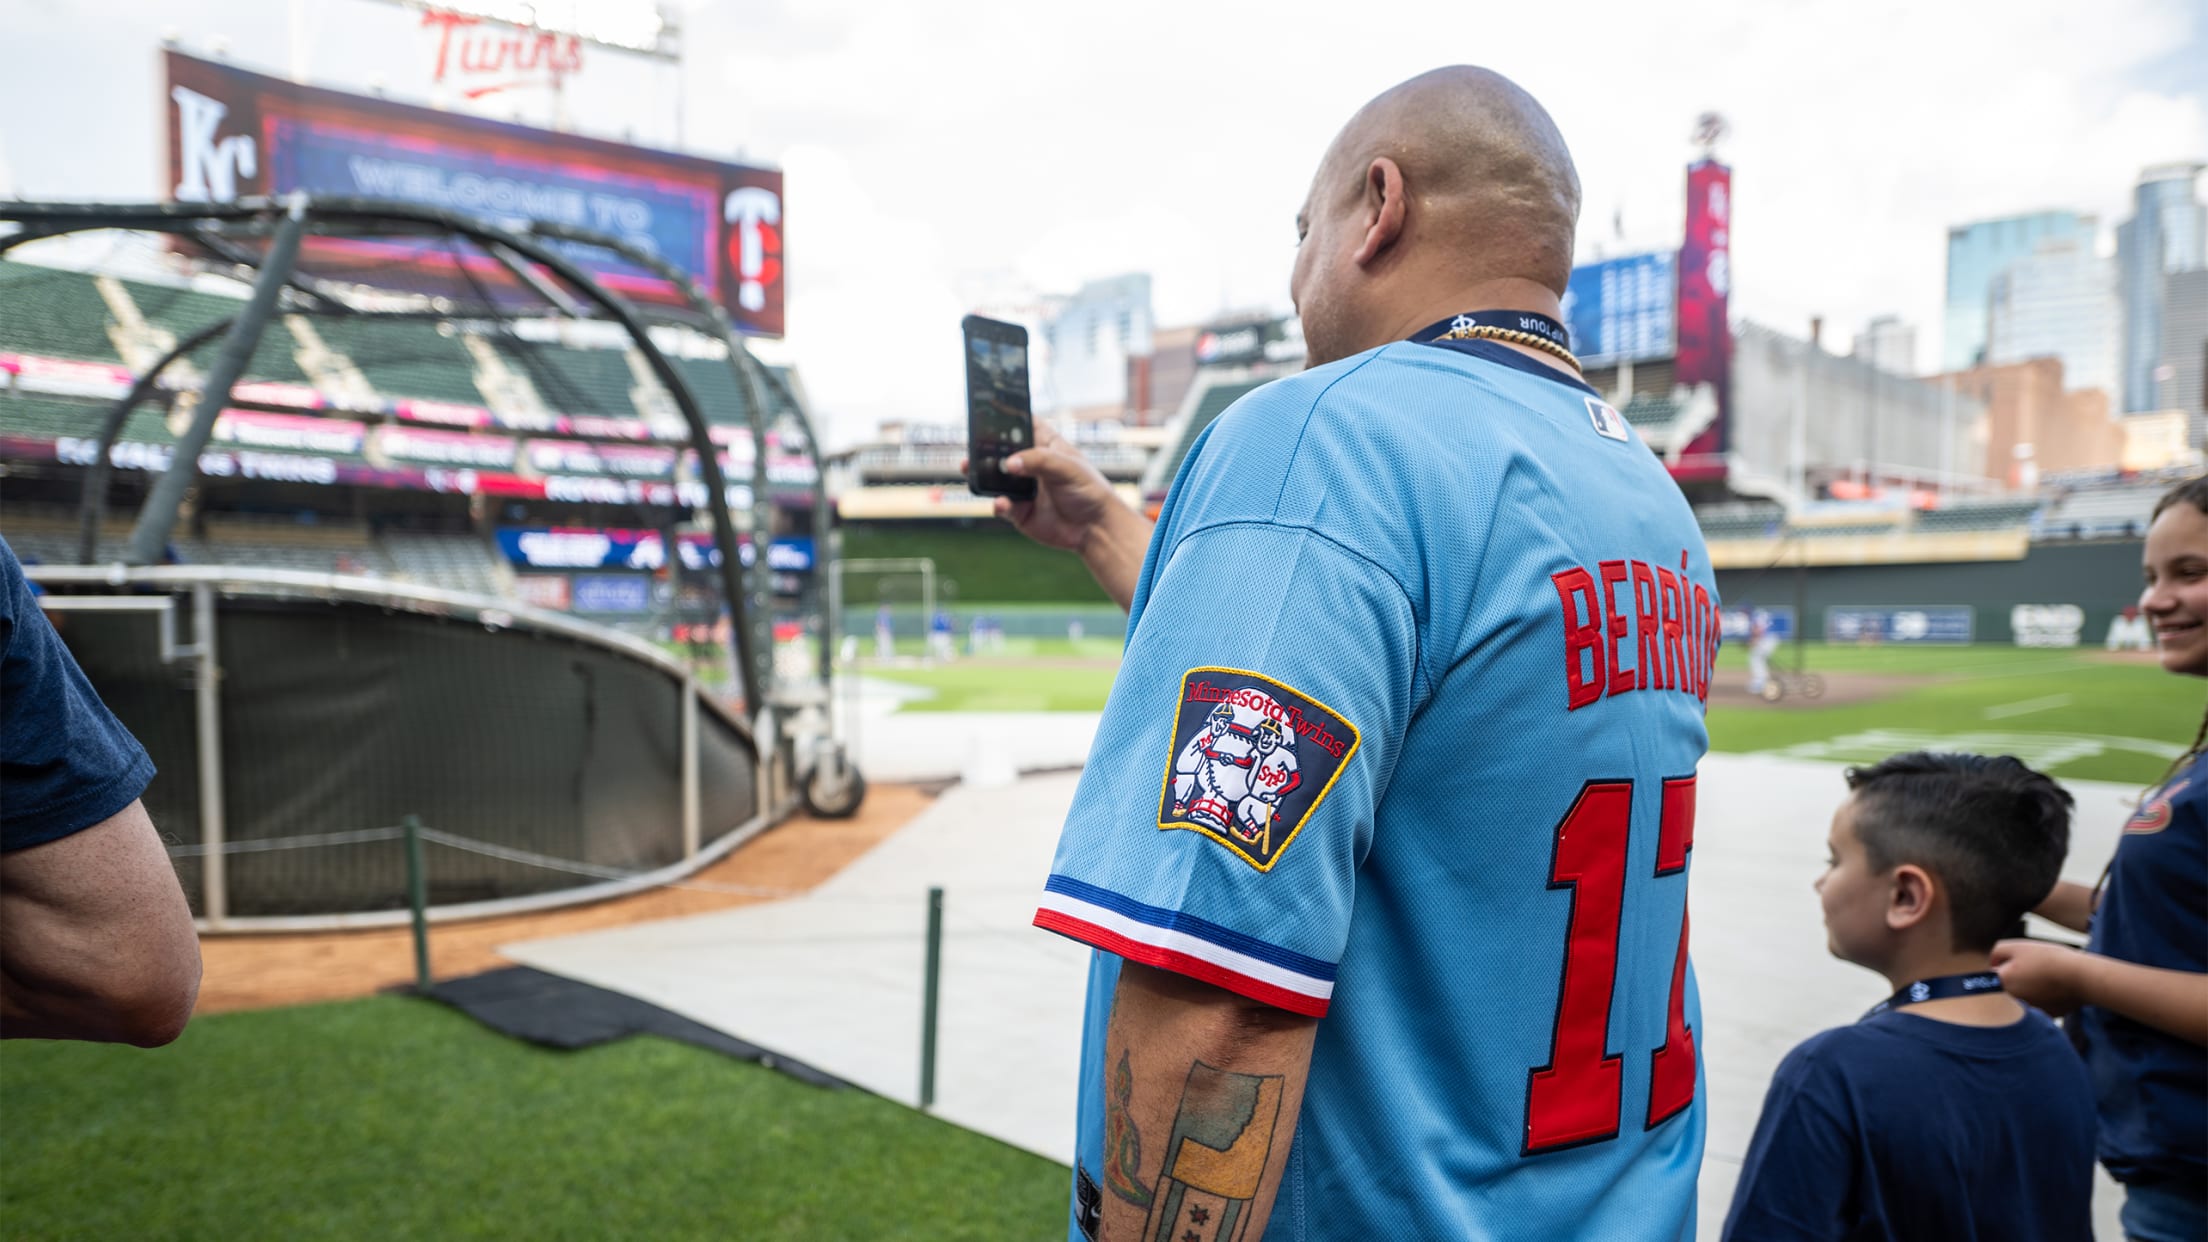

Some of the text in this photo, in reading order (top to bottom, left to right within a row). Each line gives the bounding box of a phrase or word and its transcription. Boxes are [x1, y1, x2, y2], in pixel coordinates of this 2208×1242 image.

[421, 10, 581, 82] Twins
[348, 154, 655, 234] WELCOME TO
[1519, 317, 1551, 337] TOUR
[1186, 681, 1346, 759] Minnesota Twins
[1520, 773, 1698, 1157] 17
